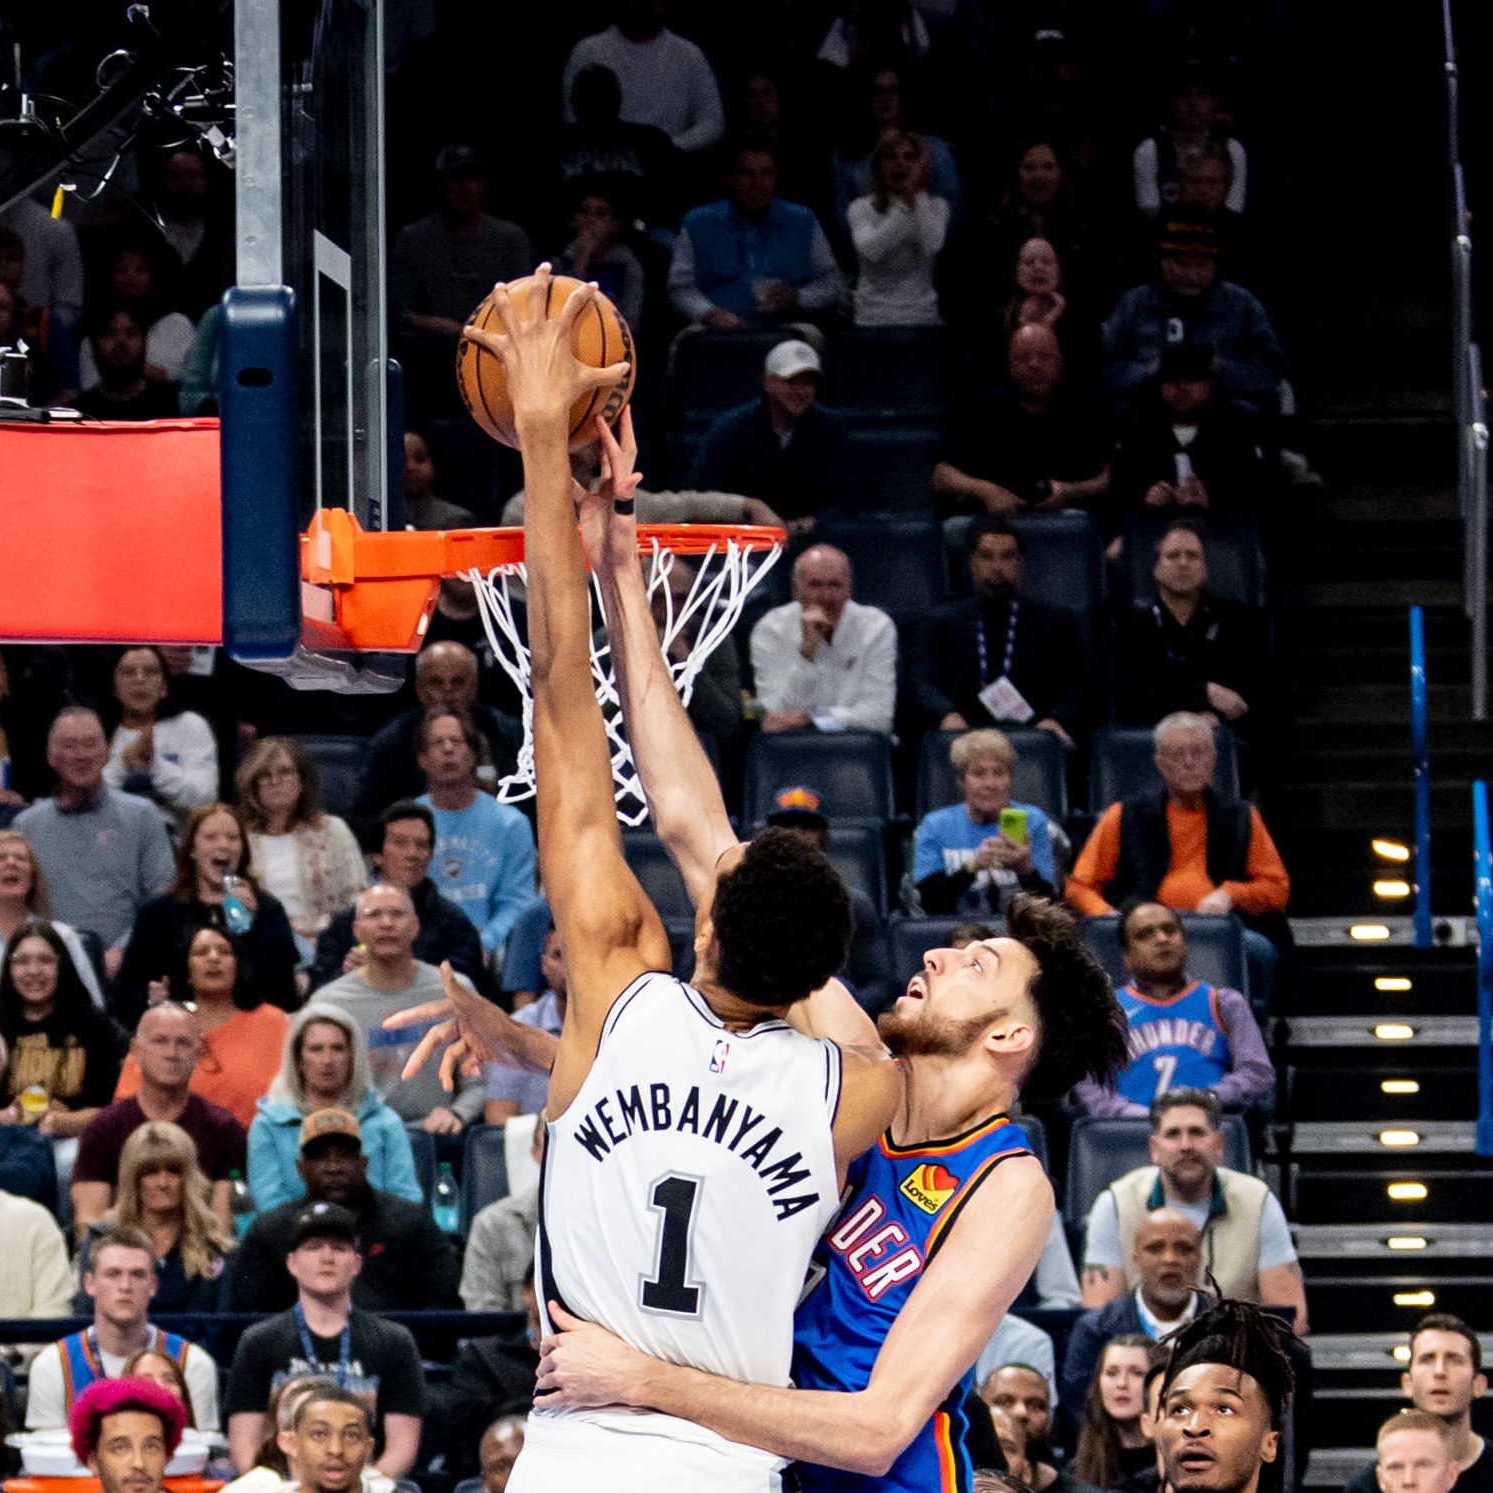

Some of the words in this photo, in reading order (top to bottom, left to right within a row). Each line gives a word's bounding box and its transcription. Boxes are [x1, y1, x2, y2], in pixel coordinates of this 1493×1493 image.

[1127, 1016, 1217, 1063] HUNDER
[573, 1082, 820, 1222] WEMBANYAMA
[640, 1171, 705, 1320] 1
